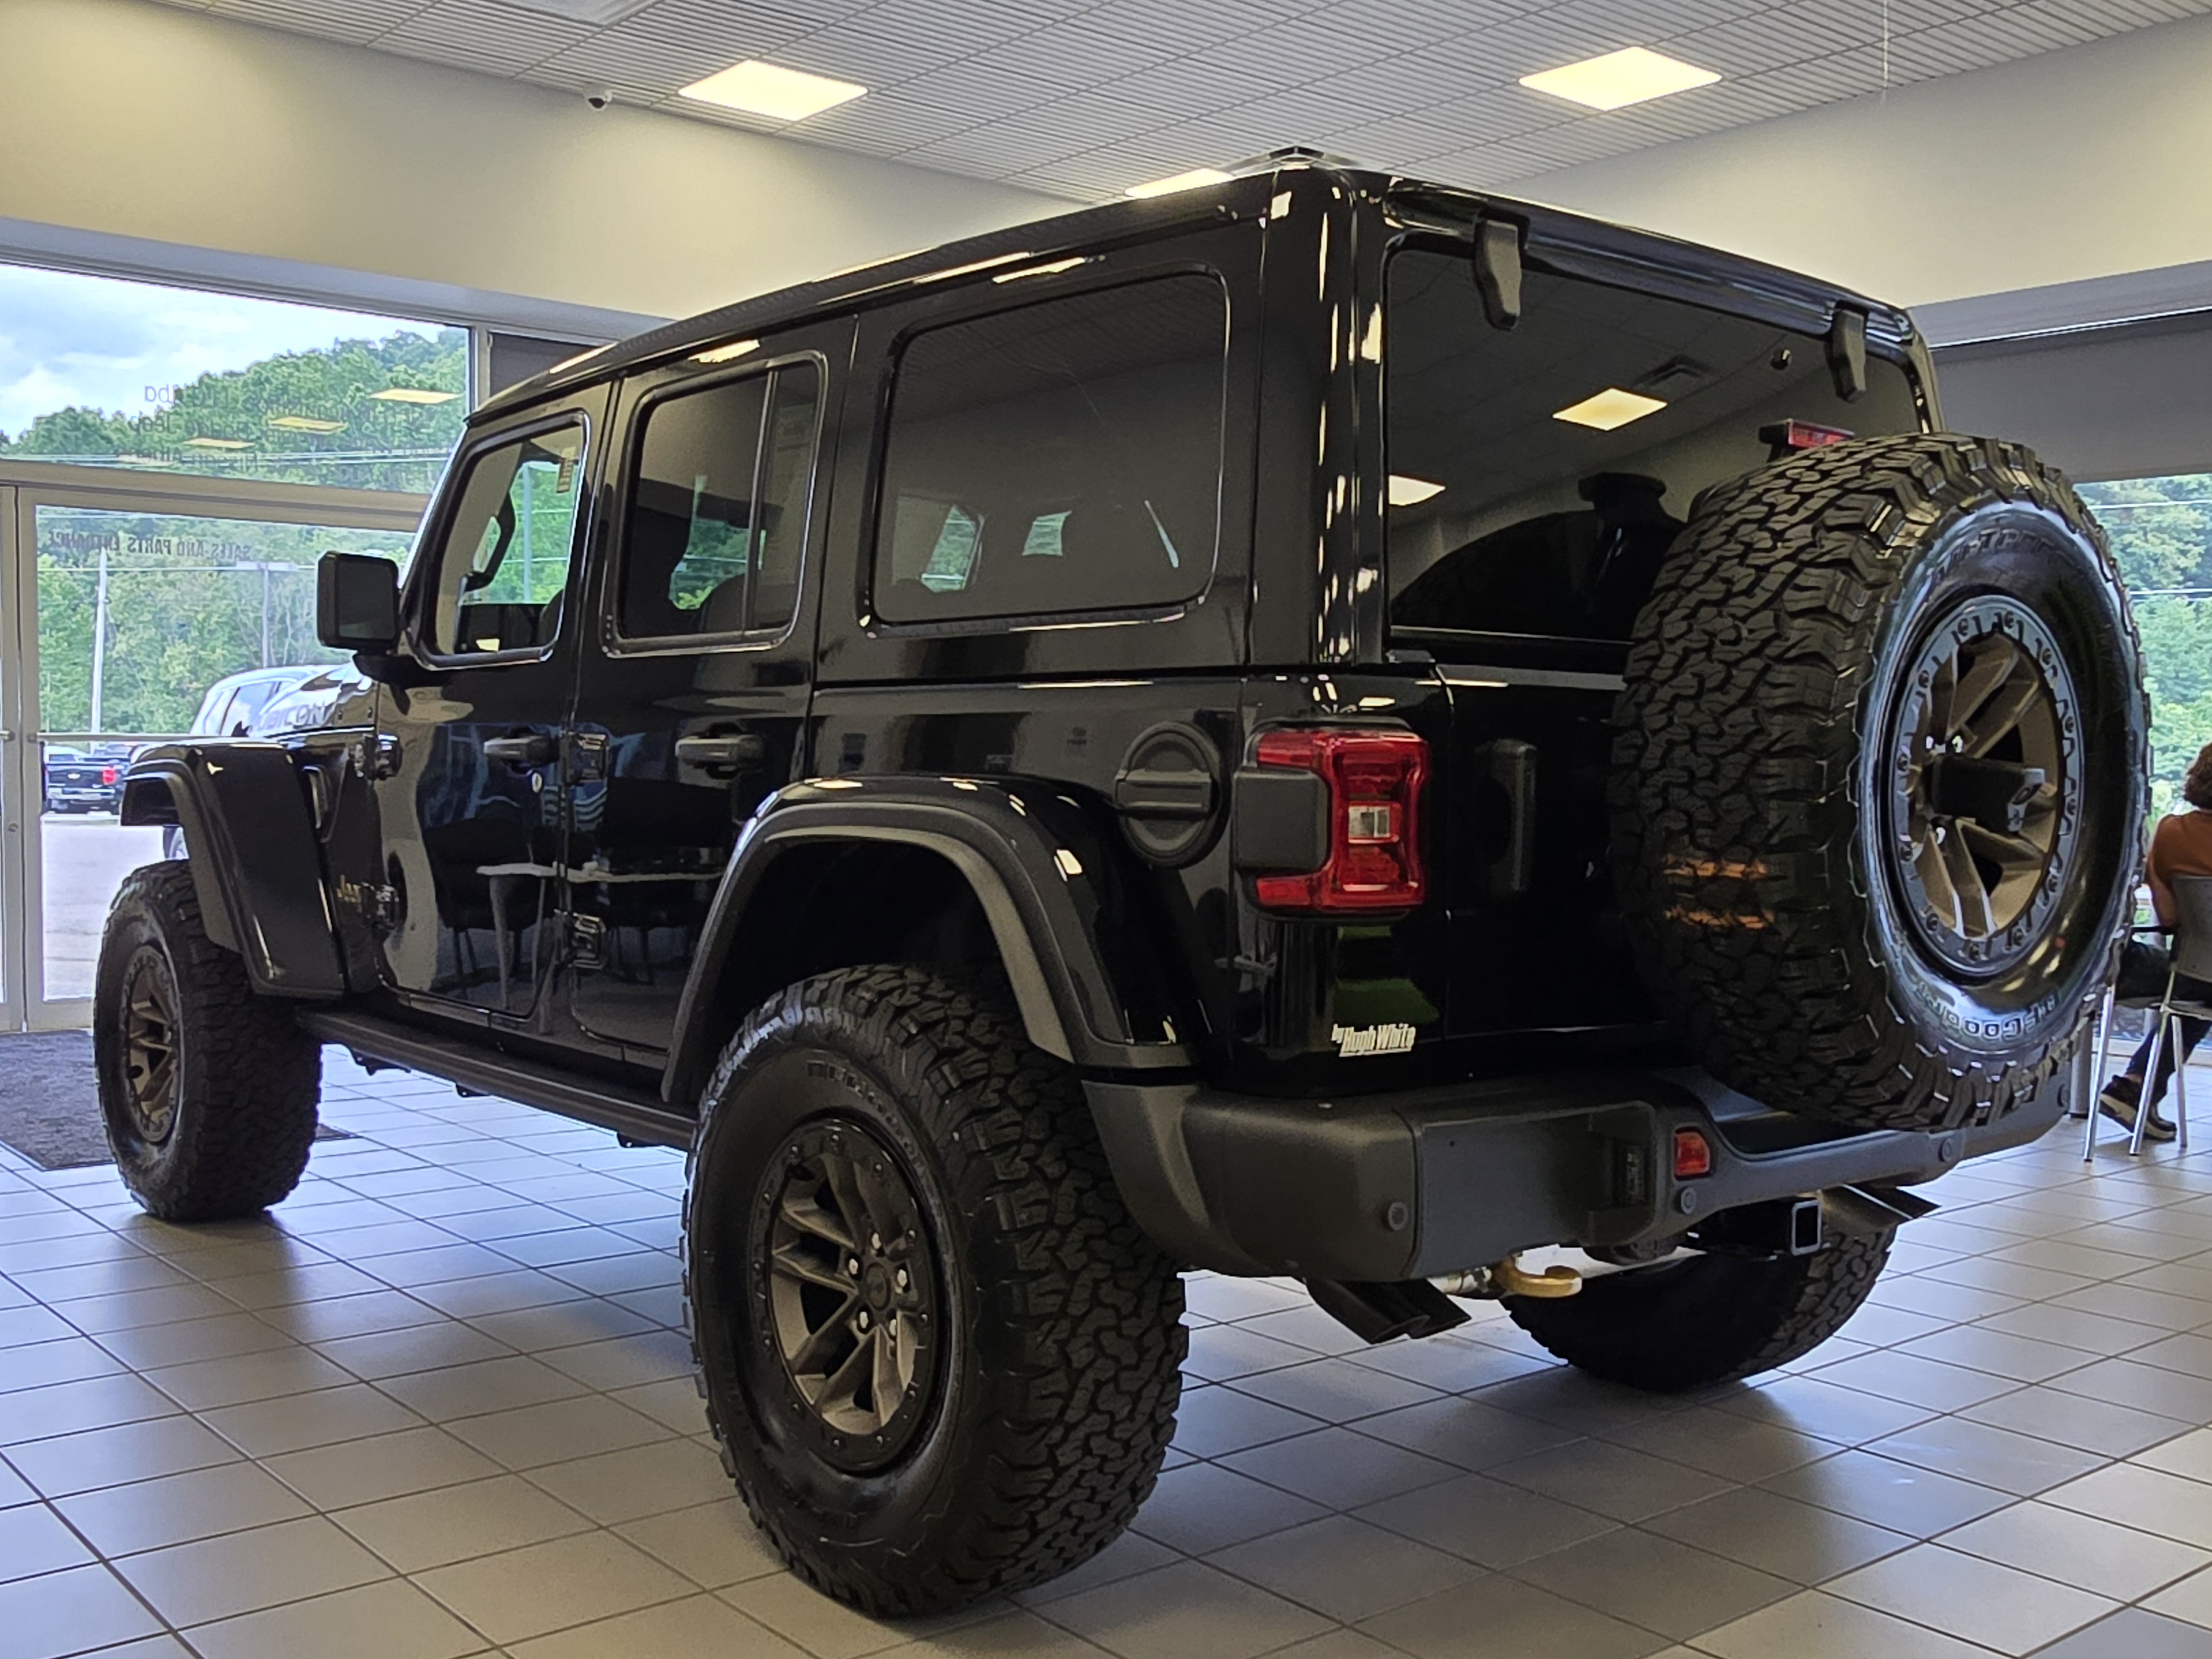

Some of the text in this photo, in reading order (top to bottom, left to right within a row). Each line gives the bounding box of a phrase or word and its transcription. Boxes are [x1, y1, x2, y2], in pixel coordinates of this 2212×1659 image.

[251, 702, 326, 732] UBICON
[1340, 1025, 1376, 1056] Hugh
[1375, 1022, 1416, 1050] White
